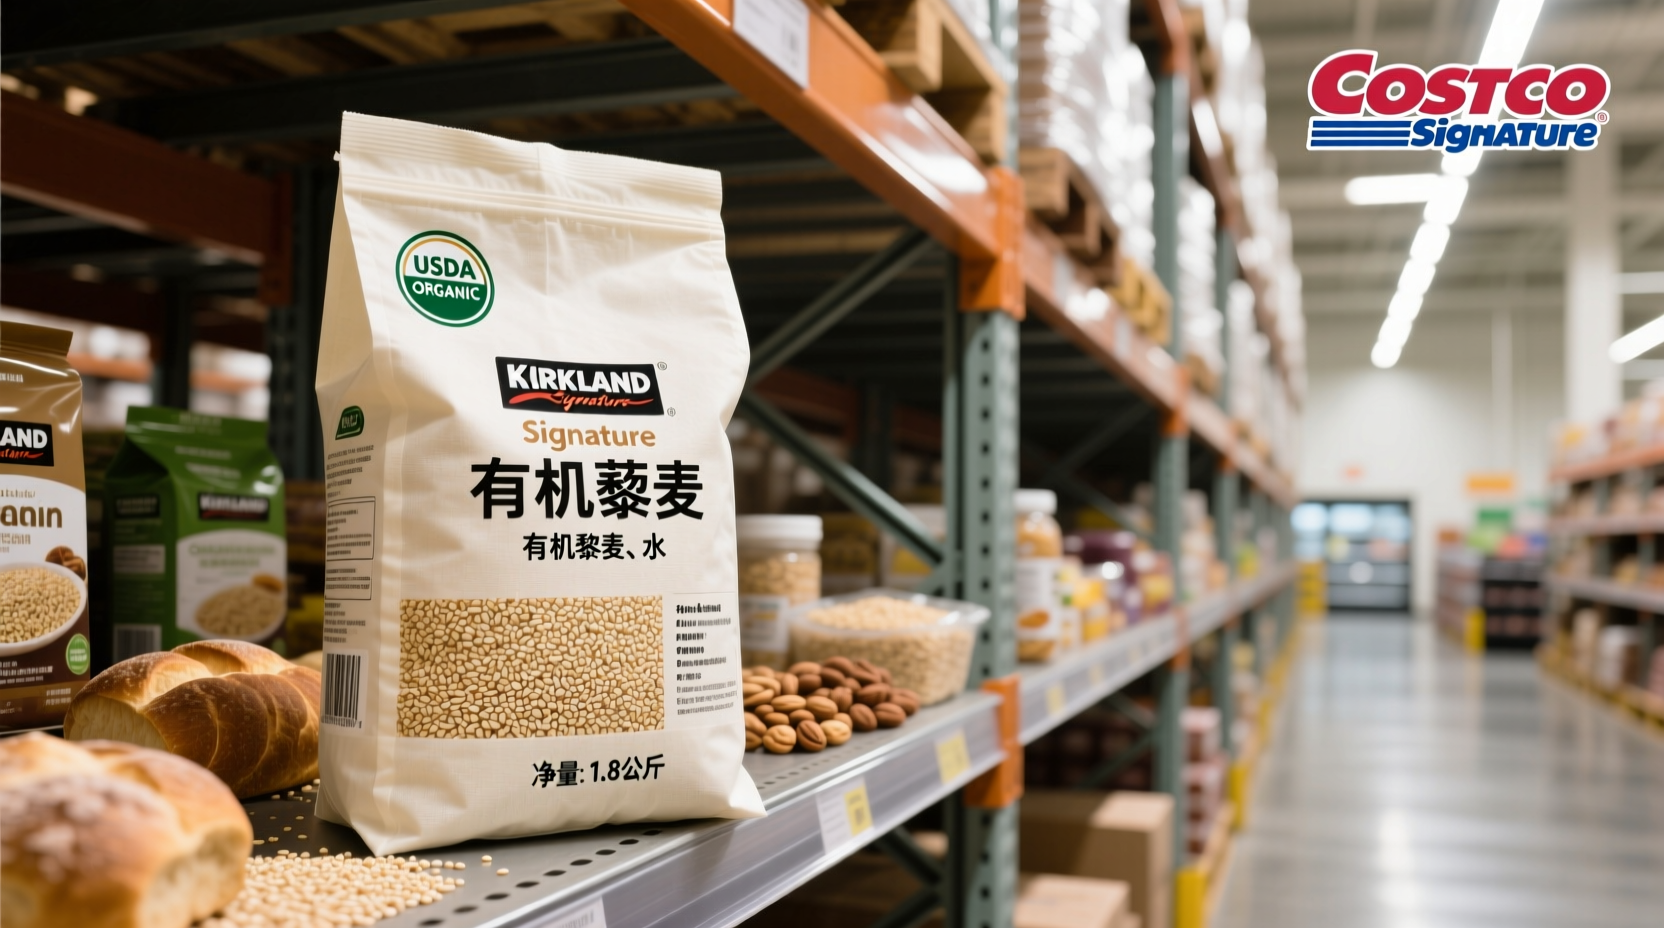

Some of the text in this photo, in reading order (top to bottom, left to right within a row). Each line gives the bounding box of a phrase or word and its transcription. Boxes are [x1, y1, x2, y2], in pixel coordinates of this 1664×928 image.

[413, 254, 477, 280] USDA
[411, 280, 481, 301] ORGANIC
[506, 363, 652, 395] KIRKLAND
[522, 420, 656, 452] Signature
[470, 457, 704, 520] 有机藜麦
[590, 753, 666, 783] 1.8公斤
